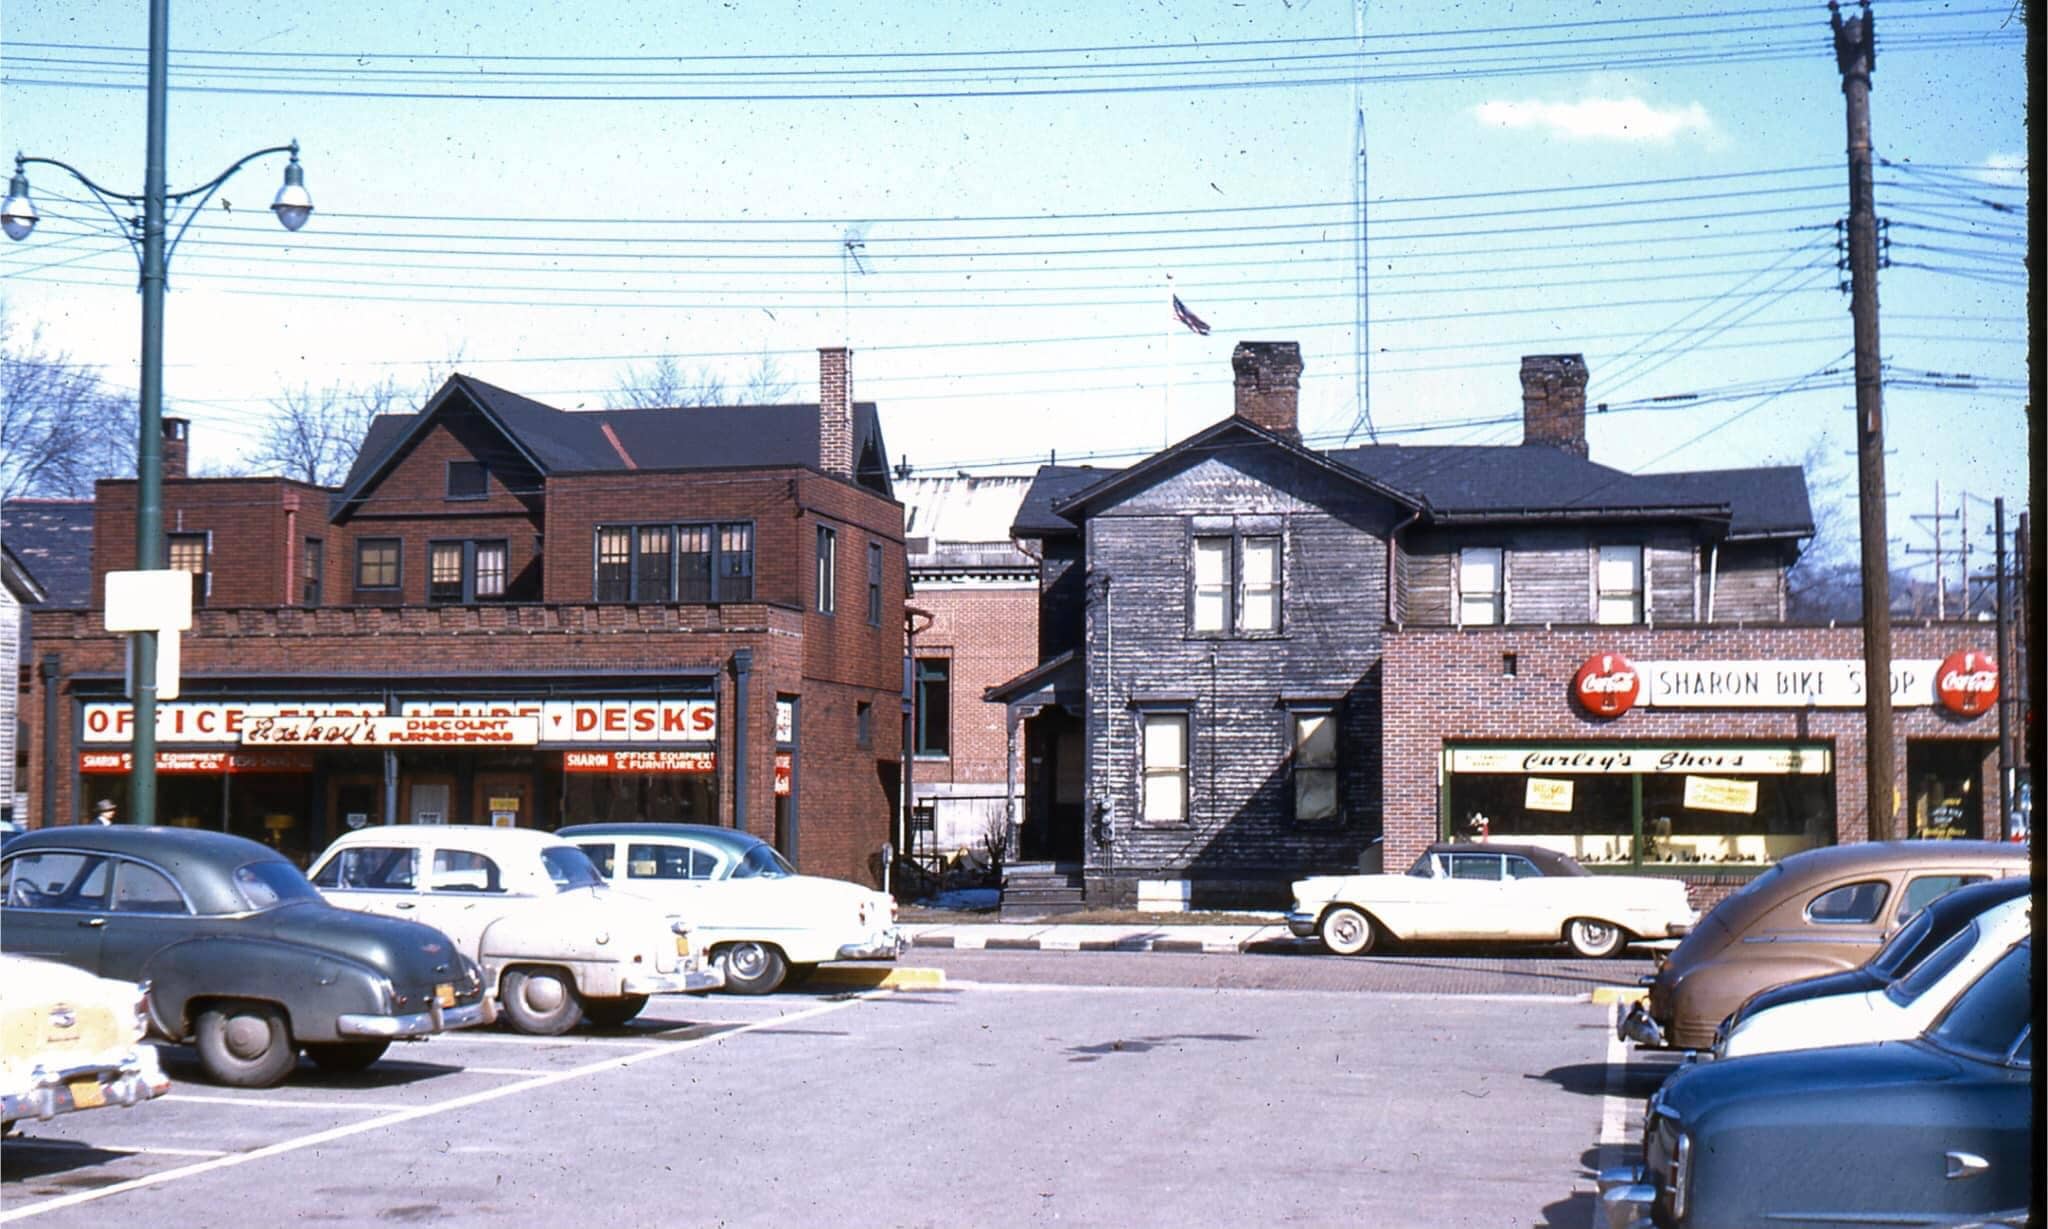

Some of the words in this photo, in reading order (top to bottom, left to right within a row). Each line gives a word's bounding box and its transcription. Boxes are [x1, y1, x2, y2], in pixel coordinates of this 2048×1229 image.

[1660, 671, 1758, 695] SHARON
[1777, 671, 1823, 695] BIKE
[1849, 671, 1914, 695] SOP
[88, 709, 243, 734] OFICE
[575, 707, 714, 733] DESKS
[406, 720, 508, 730] DISCOUNT
[389, 732, 513, 741] FURNISHINGS
[567, 753, 609, 766] SHARON
[614, 751, 656, 761] OFFICE
[1521, 751, 1632, 771] Curley's
[1656, 751, 1744, 771] Shoes
[630, 761, 694, 770] FURNITURE
